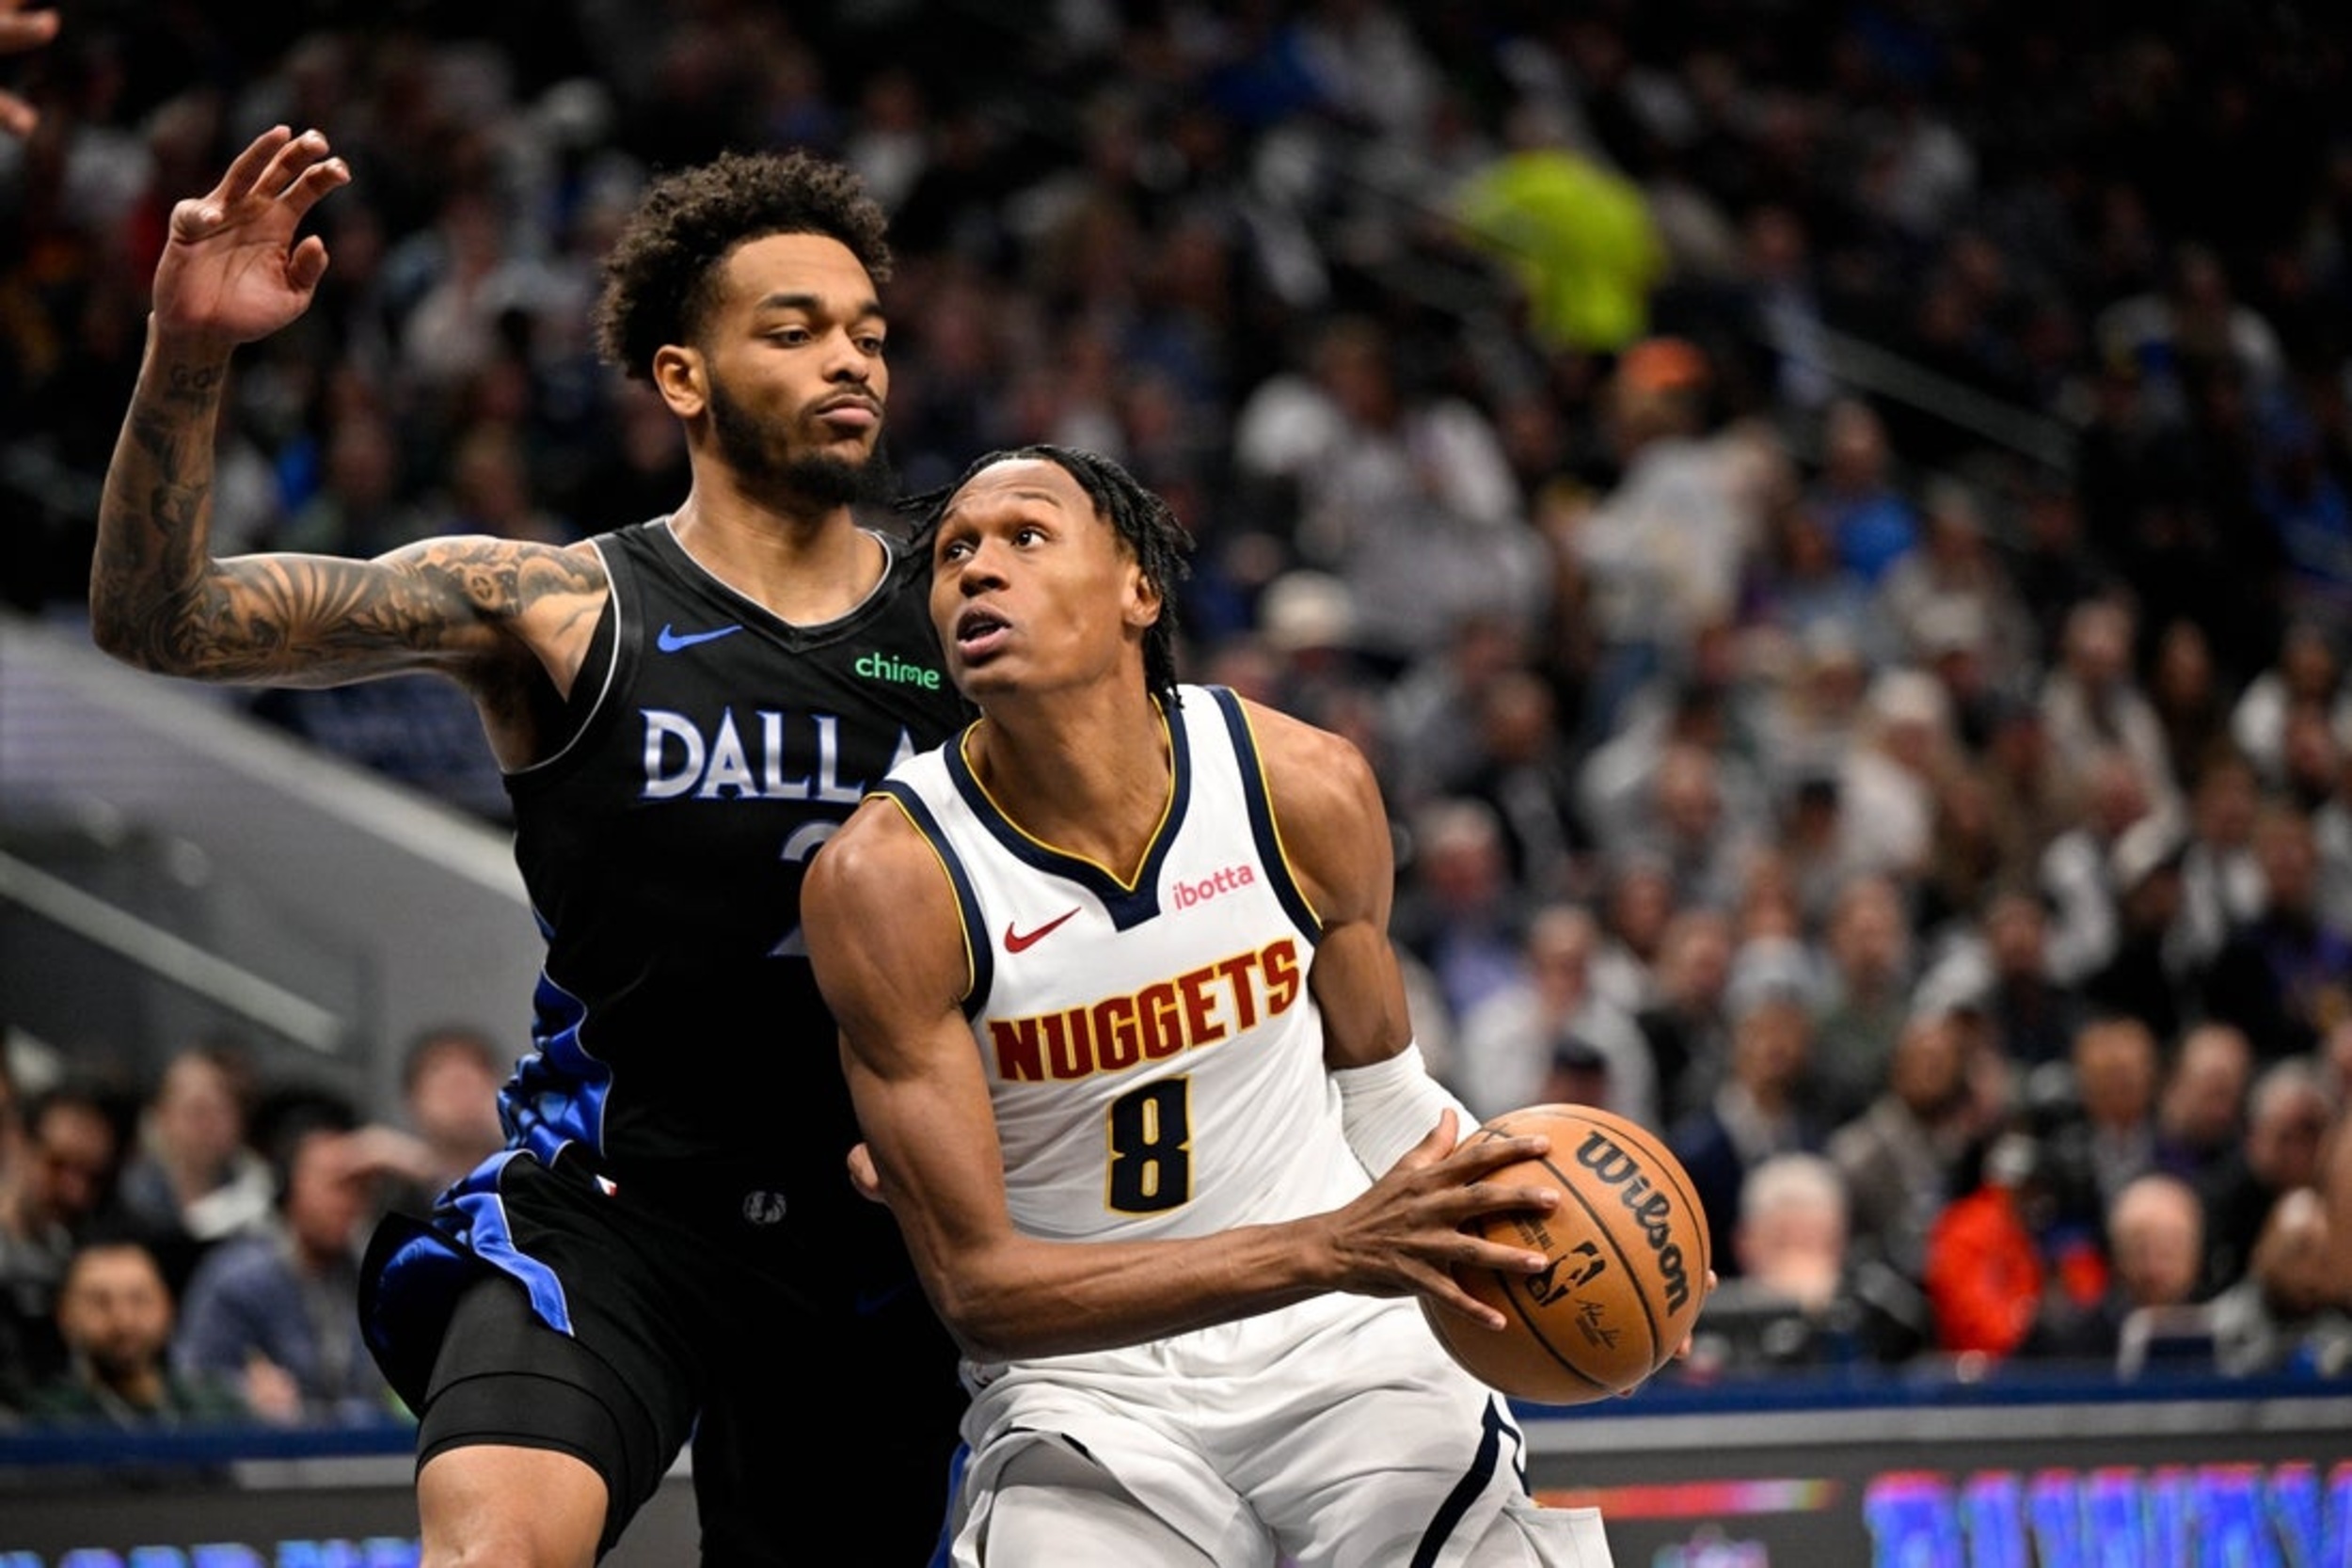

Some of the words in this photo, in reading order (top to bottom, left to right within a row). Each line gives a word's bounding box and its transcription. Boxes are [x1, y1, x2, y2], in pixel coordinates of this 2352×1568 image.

[854, 652, 941, 689] chime
[1172, 863, 1255, 911] ibotta
[987, 934, 1300, 1083] NUGGETS
[1104, 1074, 1193, 1215] 8
[1576, 1131, 1690, 1318] Wilson
